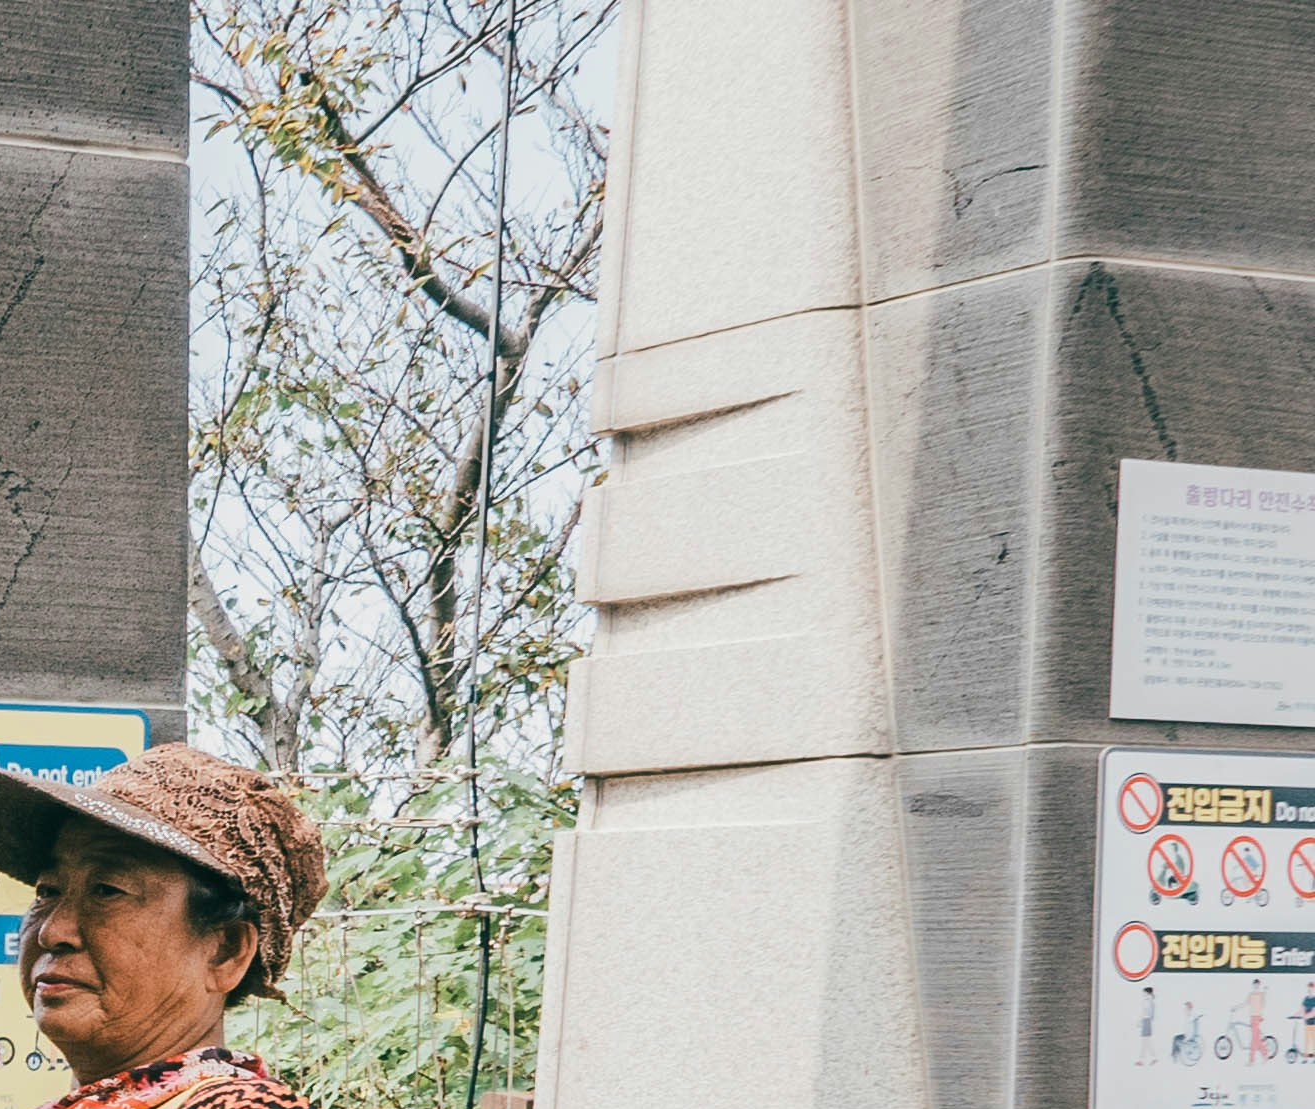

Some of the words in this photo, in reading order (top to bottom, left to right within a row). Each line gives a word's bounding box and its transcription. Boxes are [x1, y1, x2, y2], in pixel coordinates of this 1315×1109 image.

[1167, 787, 1272, 824] 진입금지
[1275, 801, 1296, 822] Do
[1161, 934, 1267, 969] 진입가능
[1272, 946, 1314, 966] Enter
